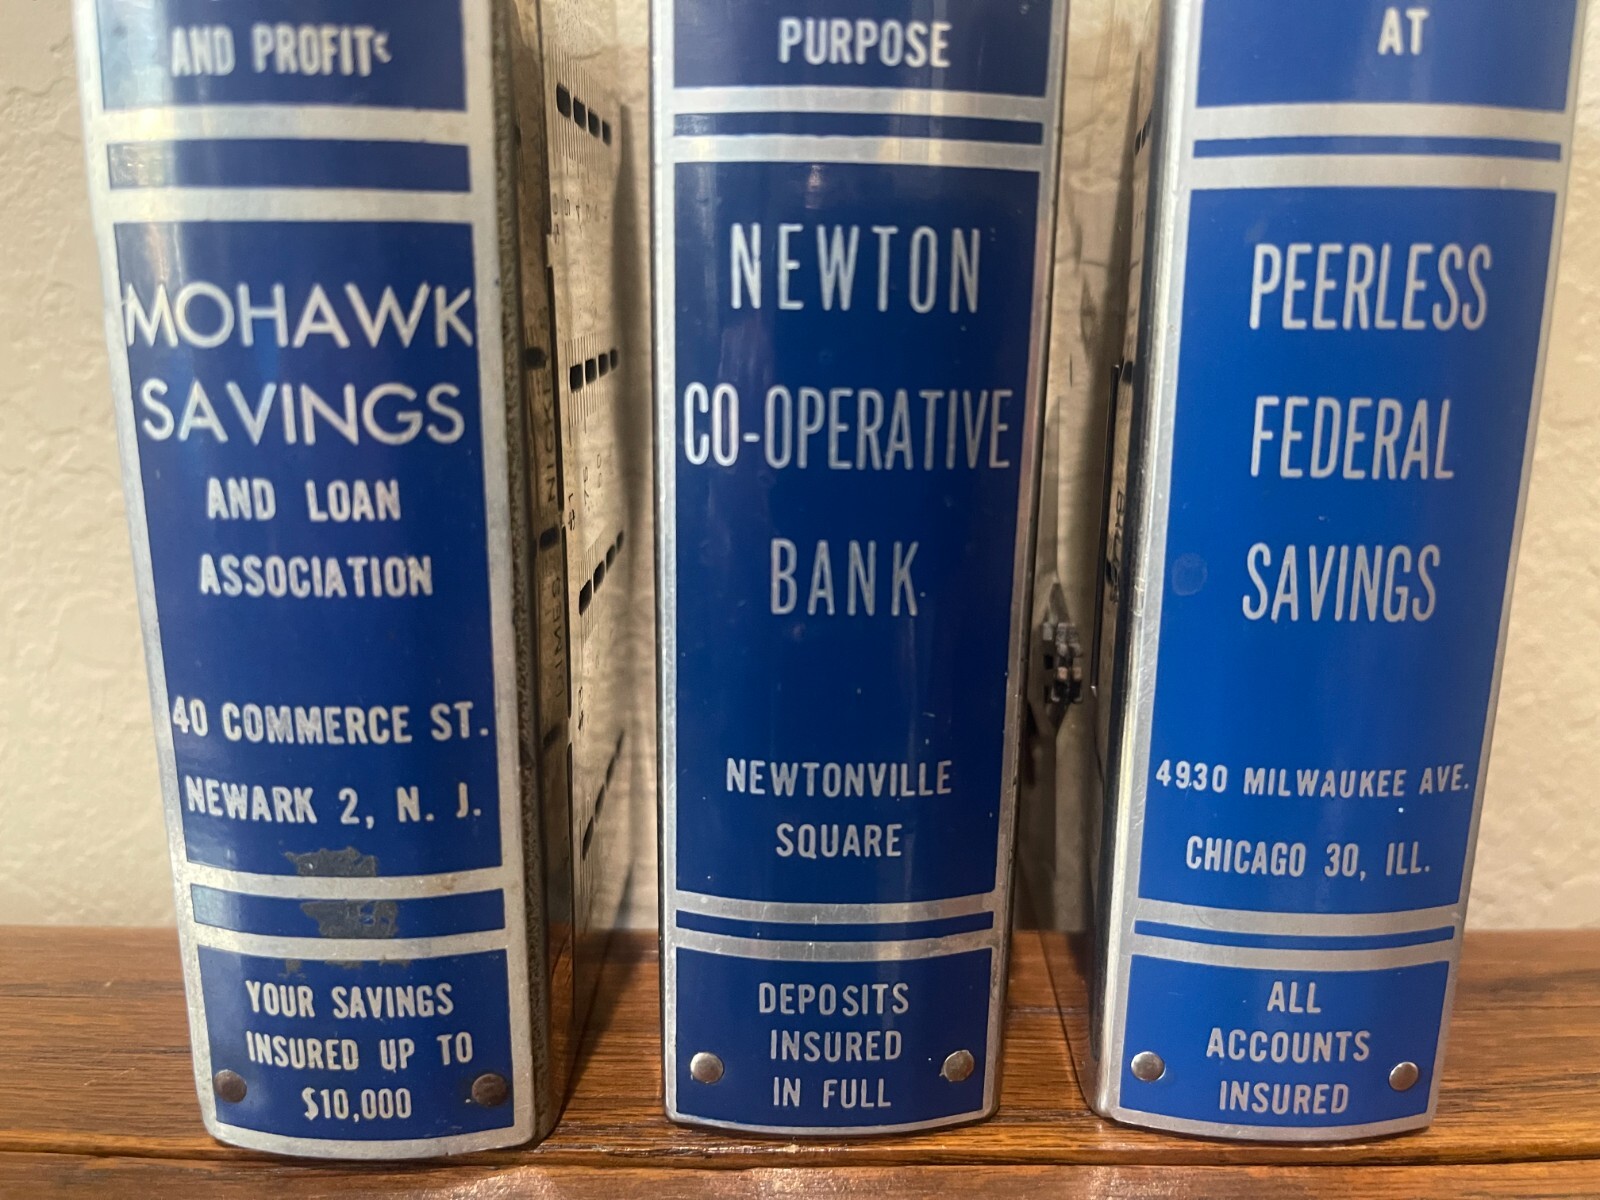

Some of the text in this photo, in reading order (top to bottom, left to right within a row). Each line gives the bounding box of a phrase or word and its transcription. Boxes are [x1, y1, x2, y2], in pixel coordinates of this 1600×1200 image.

[170, 27, 233, 77] AND
[780, 17, 951, 68] PURPOSE
[1378, 7, 1429, 55] AT
[730, 222, 979, 313] NEWTON
[1249, 243, 1491, 330] PEERLESS
[123, 279, 472, 351] MOHAWK
[139, 376, 464, 445] SAVINGS
[683, 381, 1012, 469] CO-OPERATIVE
[1250, 395, 1454, 480] FEDERAL
[207, 477, 401, 522] AND LOAN
[199, 553, 432, 598] ASSOCIATION
[770, 537, 918, 617] BANK
[1242, 542, 1440, 623] SAVINGS
[170, 696, 489, 745] 40 COMMERCE ST.
[726, 757, 952, 798] NEWTONVILLE
[1155, 759, 1469, 799] 4930 MILWAUKEE AVE.
[184, 774, 481, 829] NEWARK 2, N. J.
[775, 822, 903, 860] SQUARE
[1185, 835, 1430, 881] CHICAGO 30, ILL.
[245, 980, 454, 1019] YOUR SAVINGS
[758, 982, 909, 1017] DEPOSITS
[1266, 981, 1322, 1014] ALL
[245, 1030, 473, 1073] INSURED UP TO
[770, 1029, 902, 1063] INSURED
[1206, 1027, 1370, 1064] ACCOUNTS
[301, 1087, 412, 1123] $10,000
[773, 1076, 892, 1109] IN FULL
[1219, 1080, 1349, 1115] INSURED
